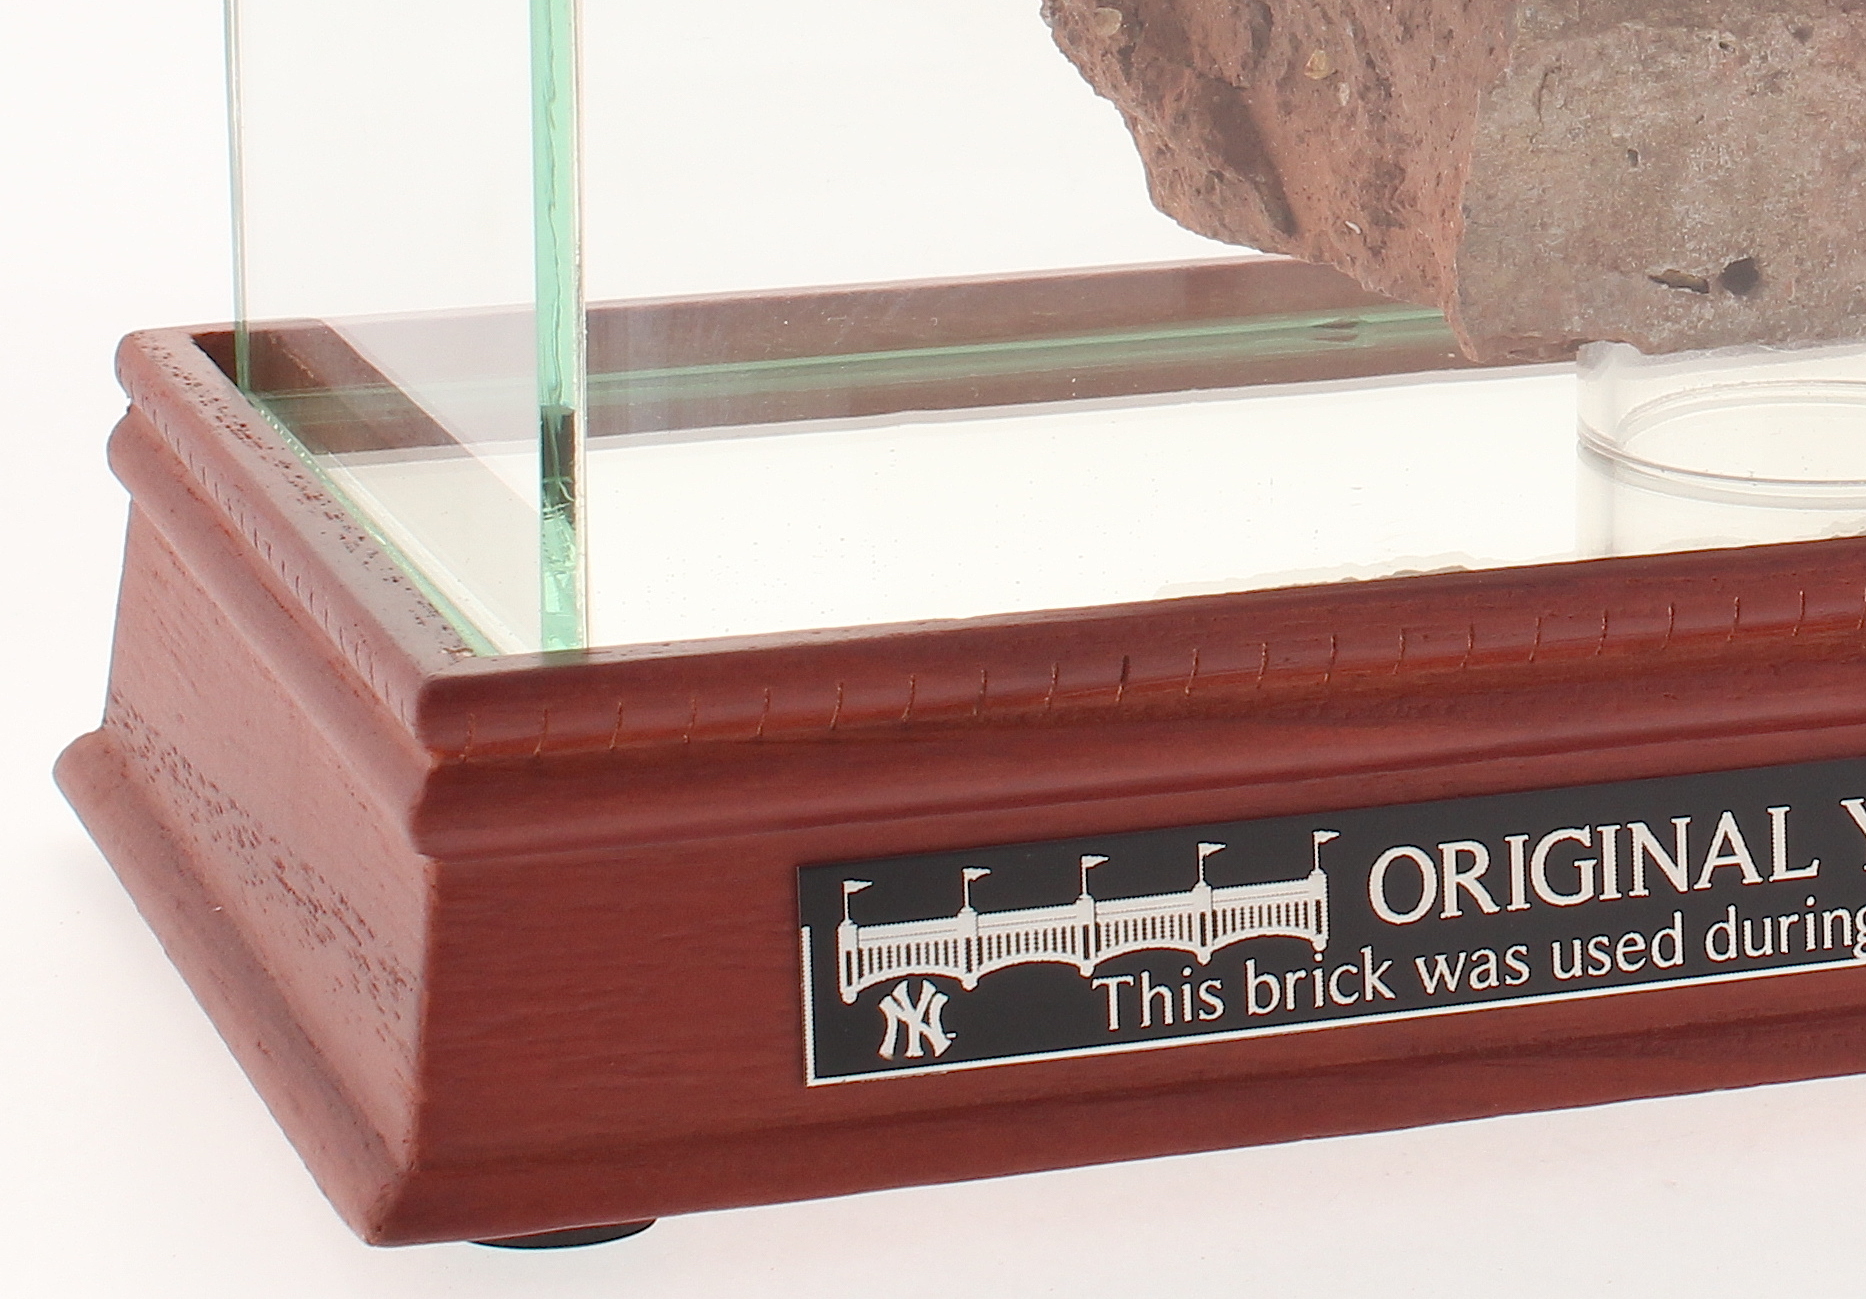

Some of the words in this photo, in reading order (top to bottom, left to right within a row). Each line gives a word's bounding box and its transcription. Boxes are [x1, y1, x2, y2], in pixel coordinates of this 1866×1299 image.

[1370, 807, 1819, 924] ORIGINAL
[878, 979, 957, 1059] NY
[1092, 968, 1223, 1030] This
[1246, 946, 1395, 1015] brick
[1416, 946, 1529, 993] was
[1552, 912, 1683, 978] used
